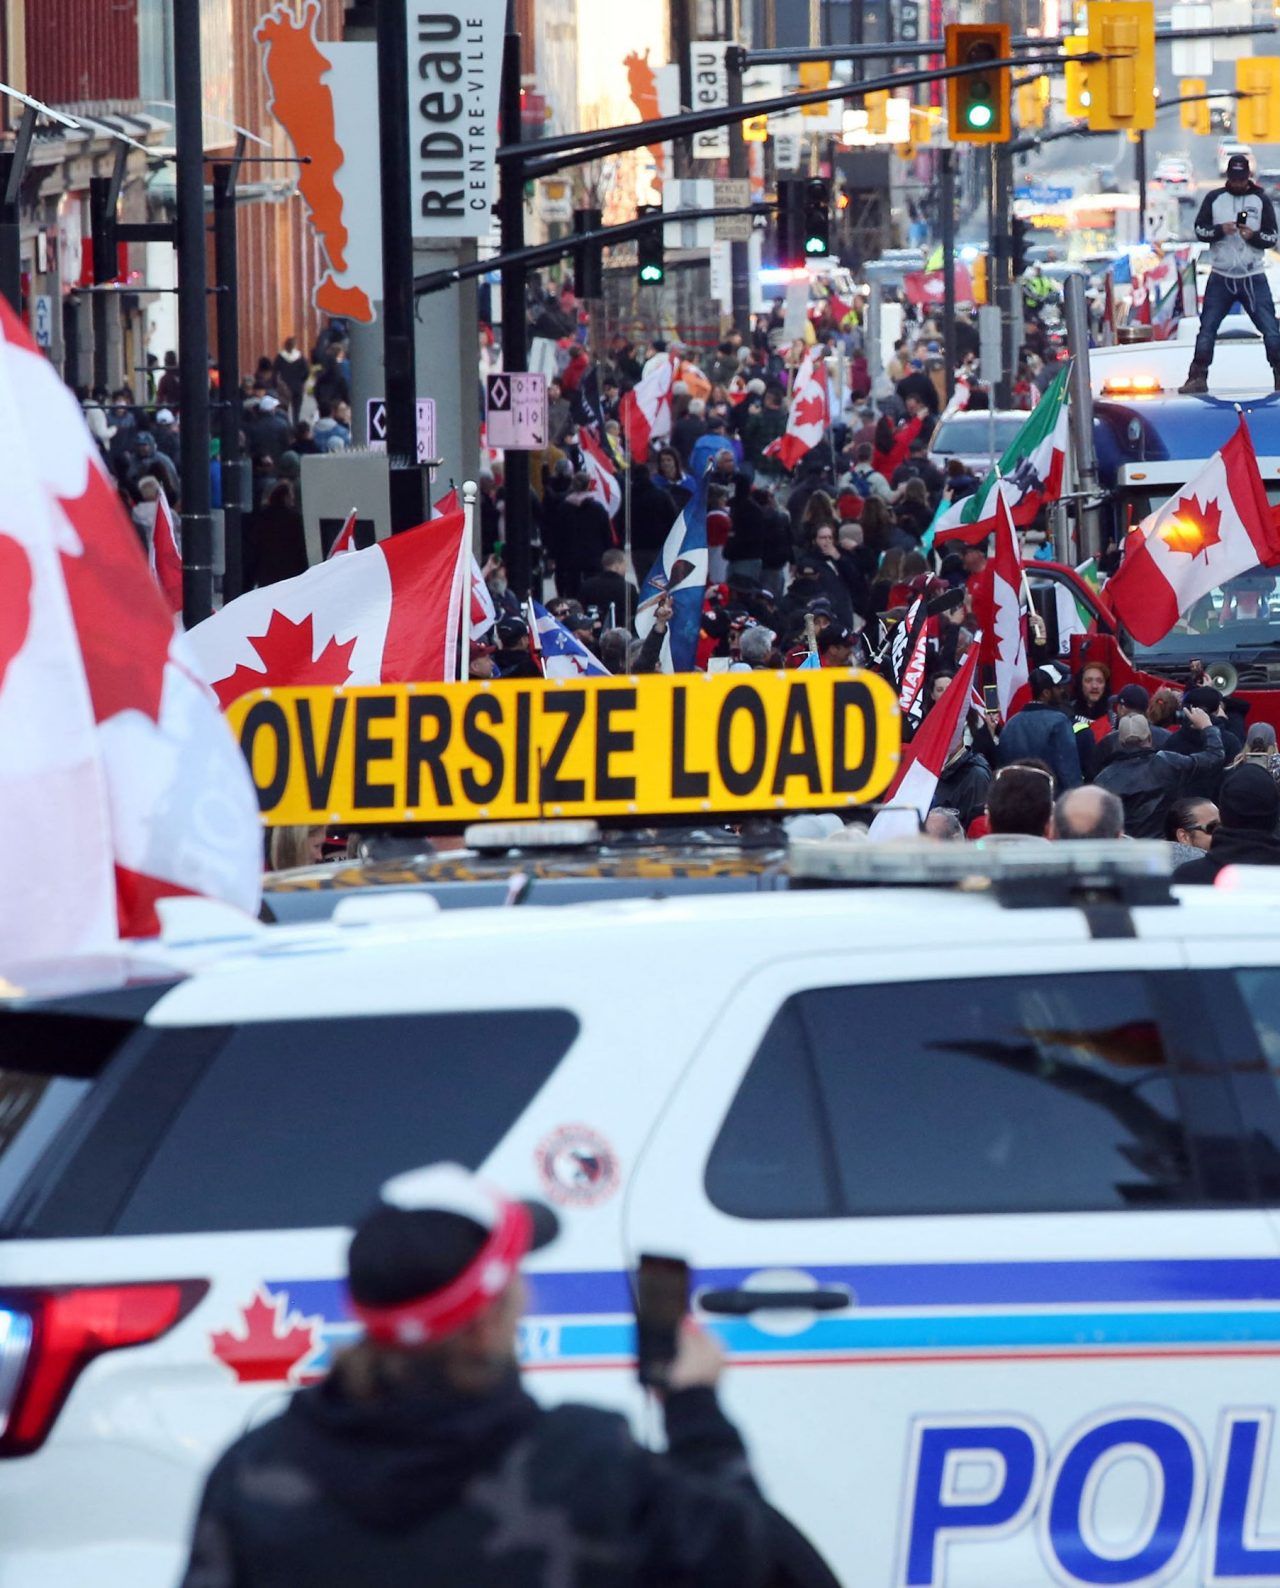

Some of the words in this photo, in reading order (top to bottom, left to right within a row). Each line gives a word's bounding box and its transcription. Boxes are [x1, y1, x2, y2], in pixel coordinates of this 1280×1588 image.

[467, 18, 487, 211] CENTRE-VILLE
[697, 52, 720, 148] Reau
[36, 298, 50, 347] ATM
[240, 688, 637, 812] OVERSIZE
[670, 680, 877, 799] LOAD
